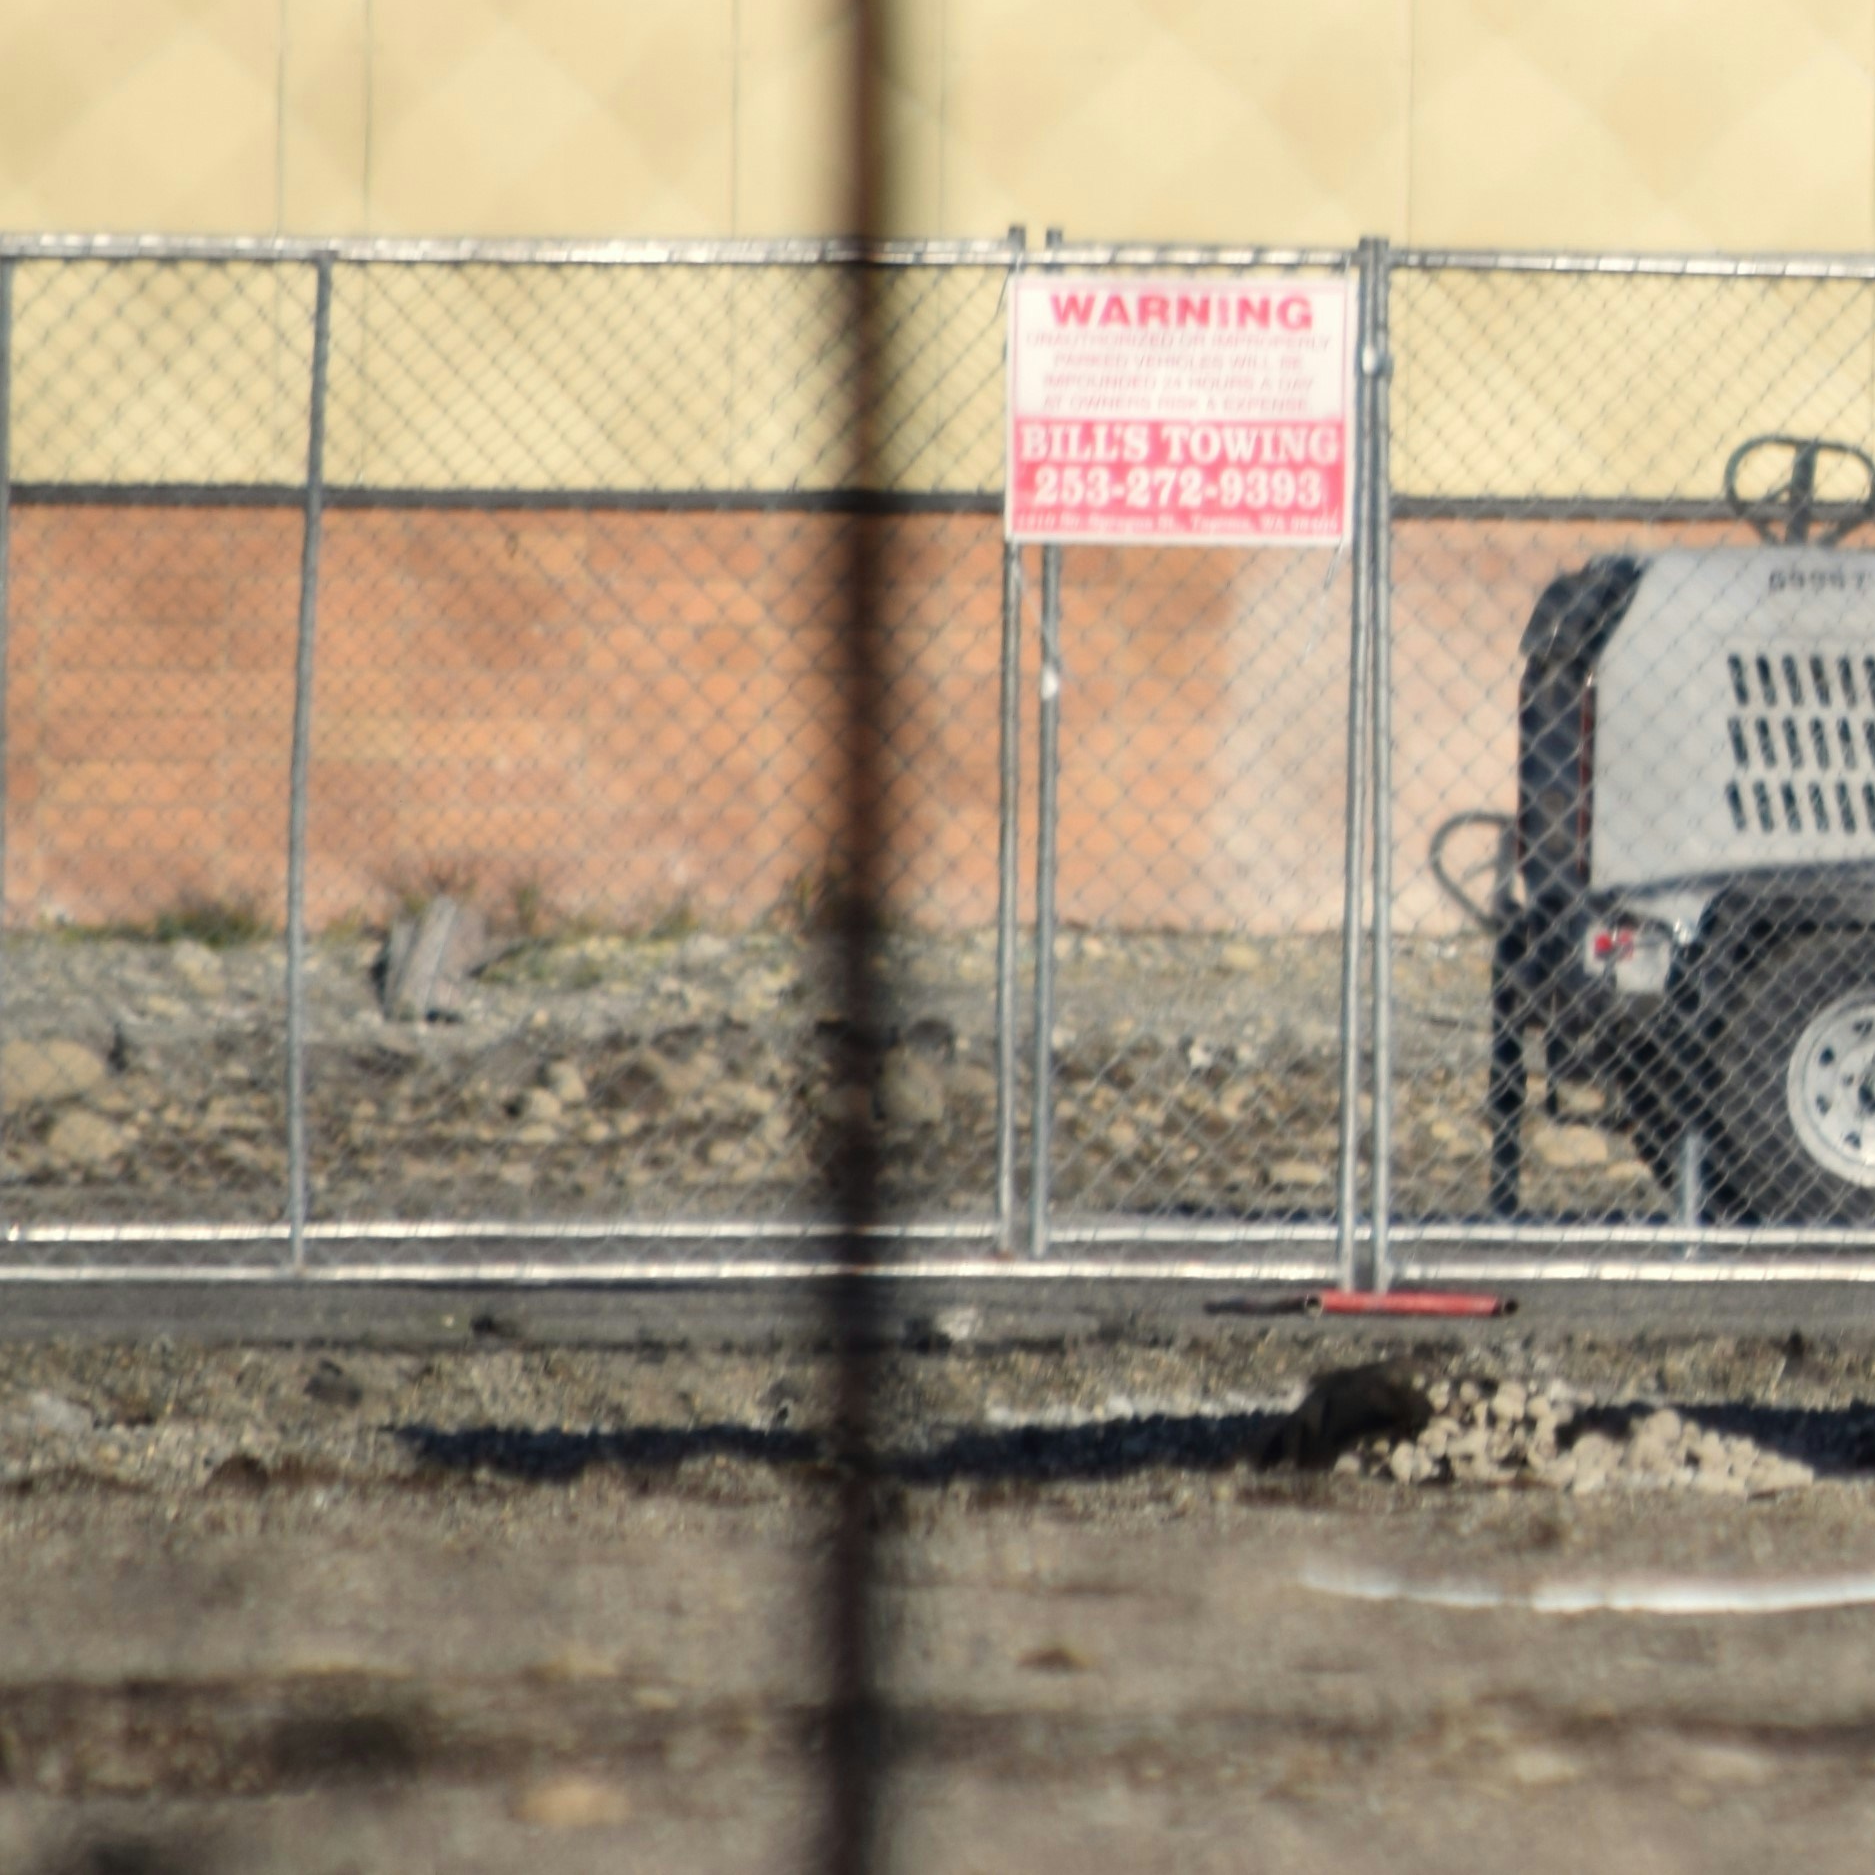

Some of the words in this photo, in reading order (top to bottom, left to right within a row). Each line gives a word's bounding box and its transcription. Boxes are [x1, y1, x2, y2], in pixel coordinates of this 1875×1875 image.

[1050, 293, 1313, 329] WARNING
[1135, 354, 1223, 369] VEHICLES
[1021, 425, 1150, 463] BILL'S
[1161, 426, 1339, 465] TOWING
[1033, 466, 1322, 509] 253-272-9393
